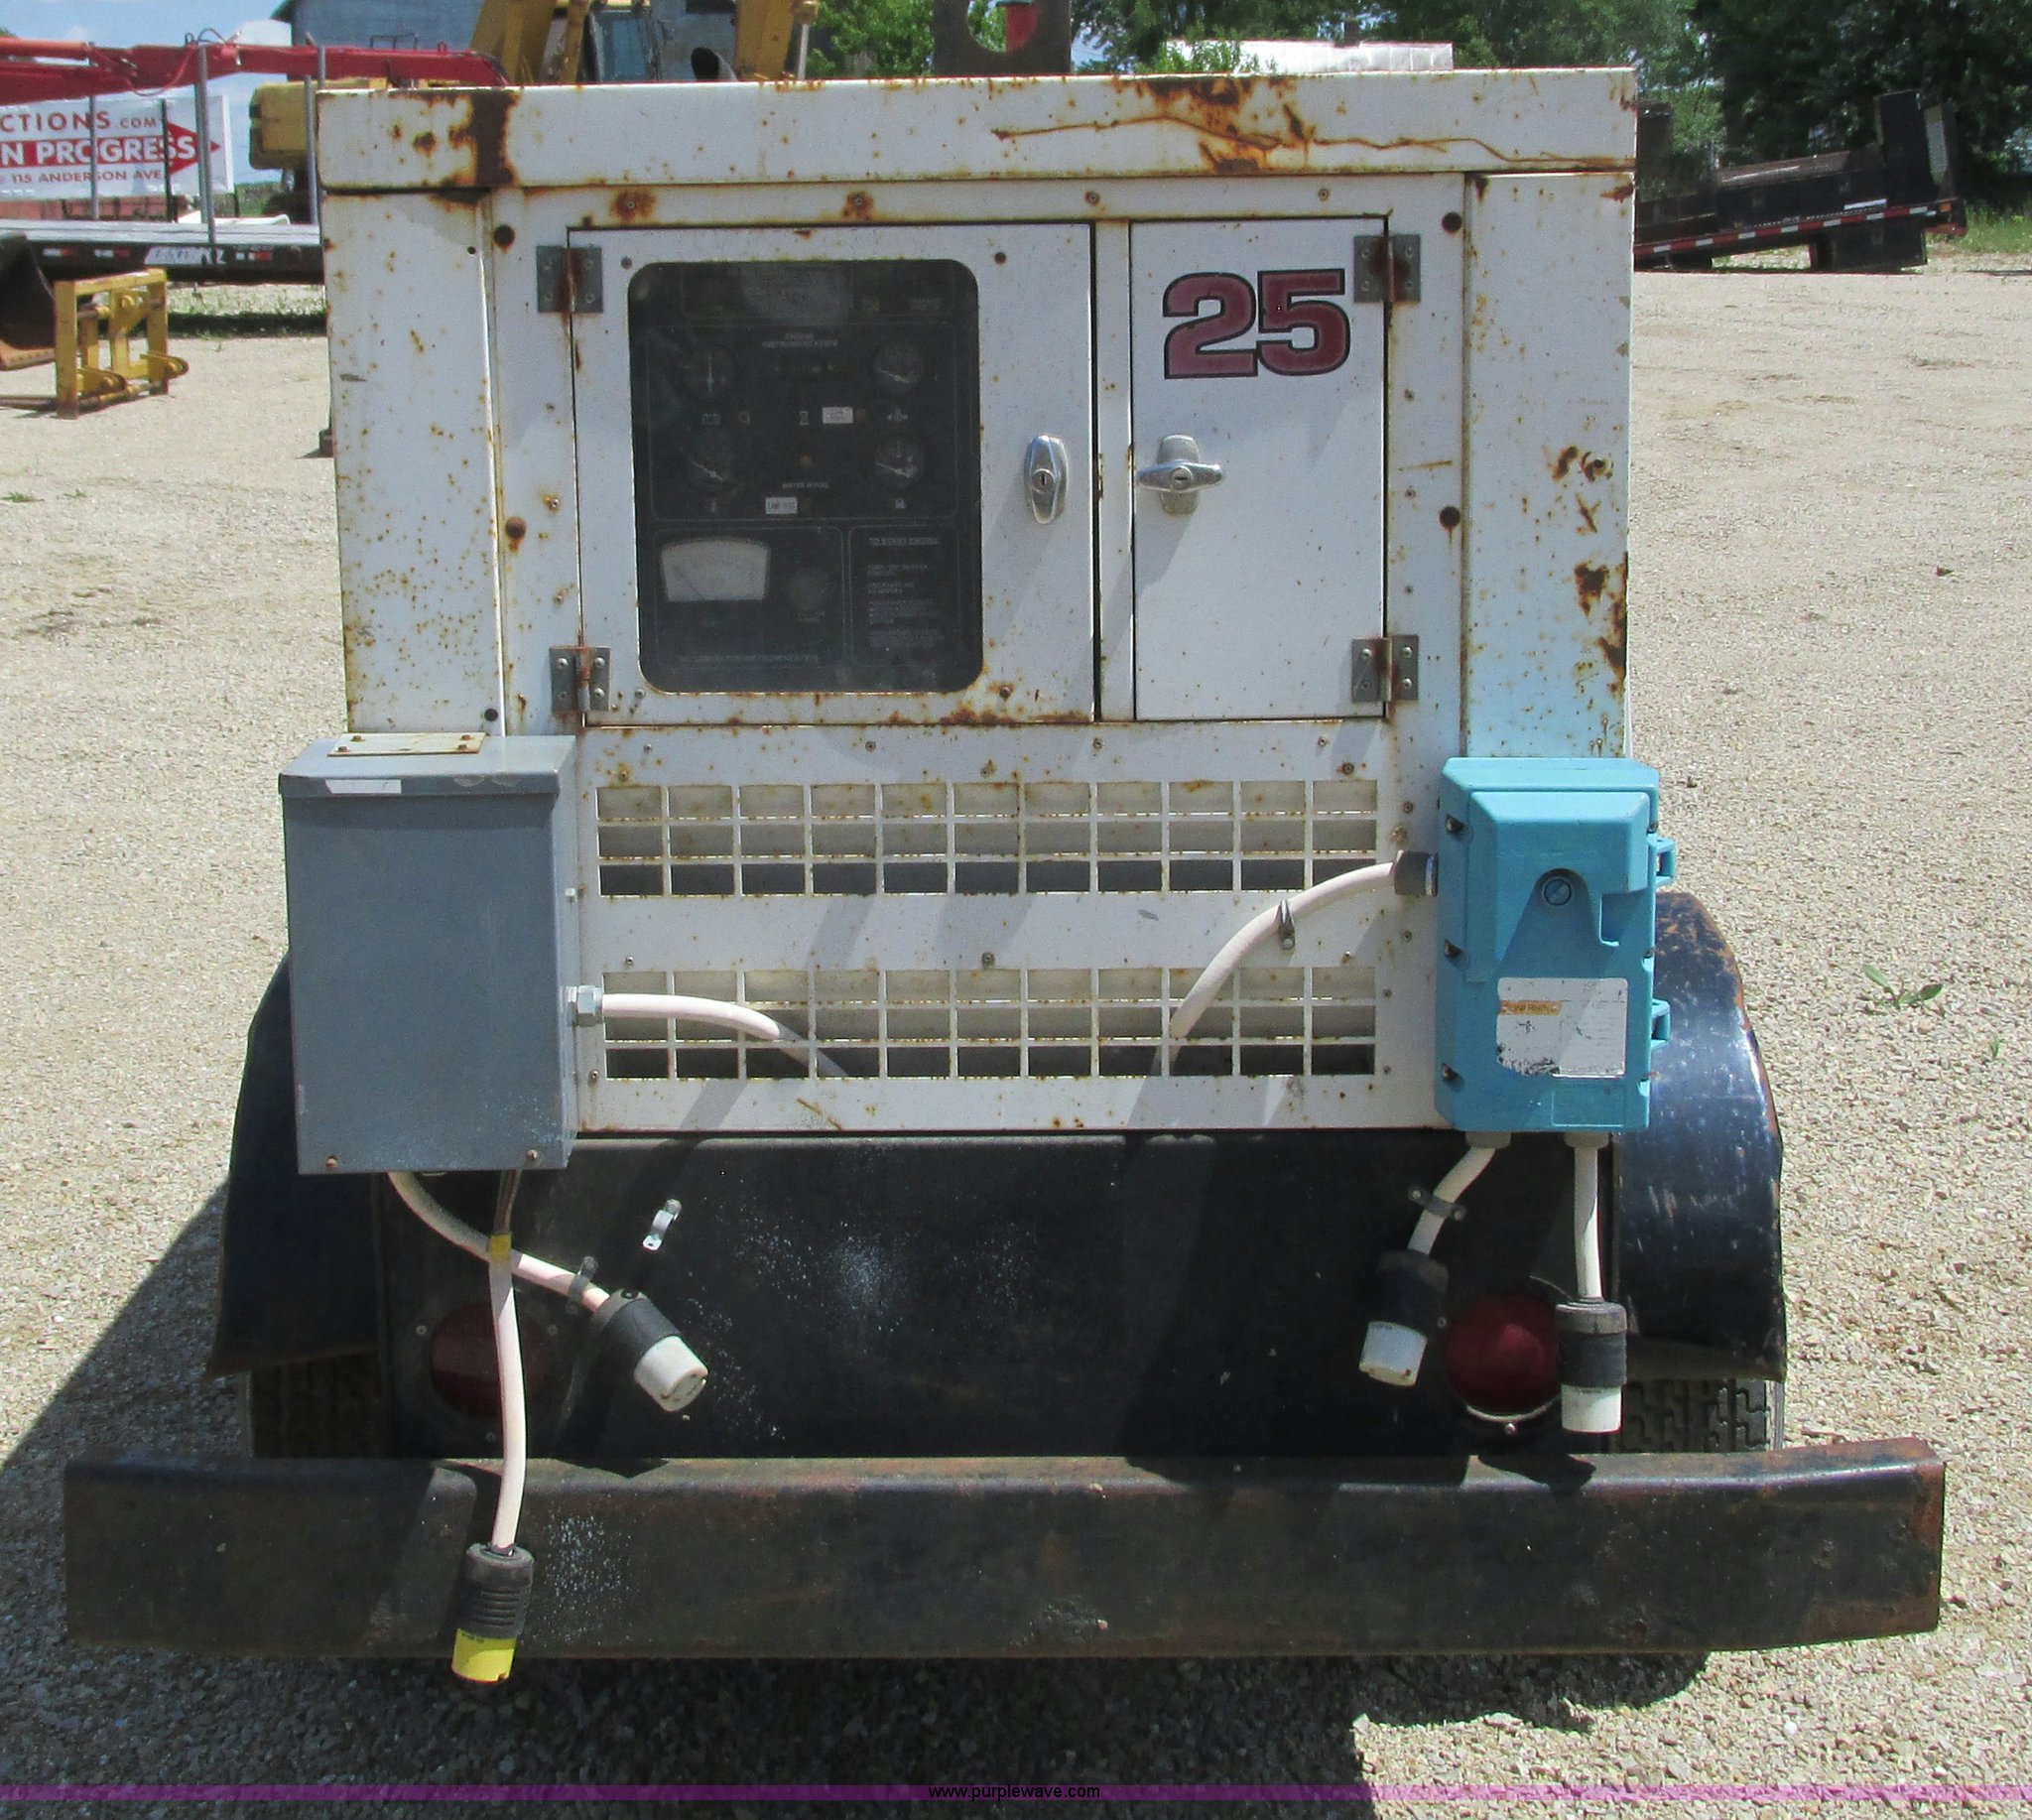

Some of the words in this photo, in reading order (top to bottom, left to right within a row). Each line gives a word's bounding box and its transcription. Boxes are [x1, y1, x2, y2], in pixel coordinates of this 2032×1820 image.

[37, 136, 195, 165] PROGRESS
[39, 171, 127, 183] ANDERSON
[134, 170, 161, 181] AVE
[1162, 268, 1351, 380] 25
